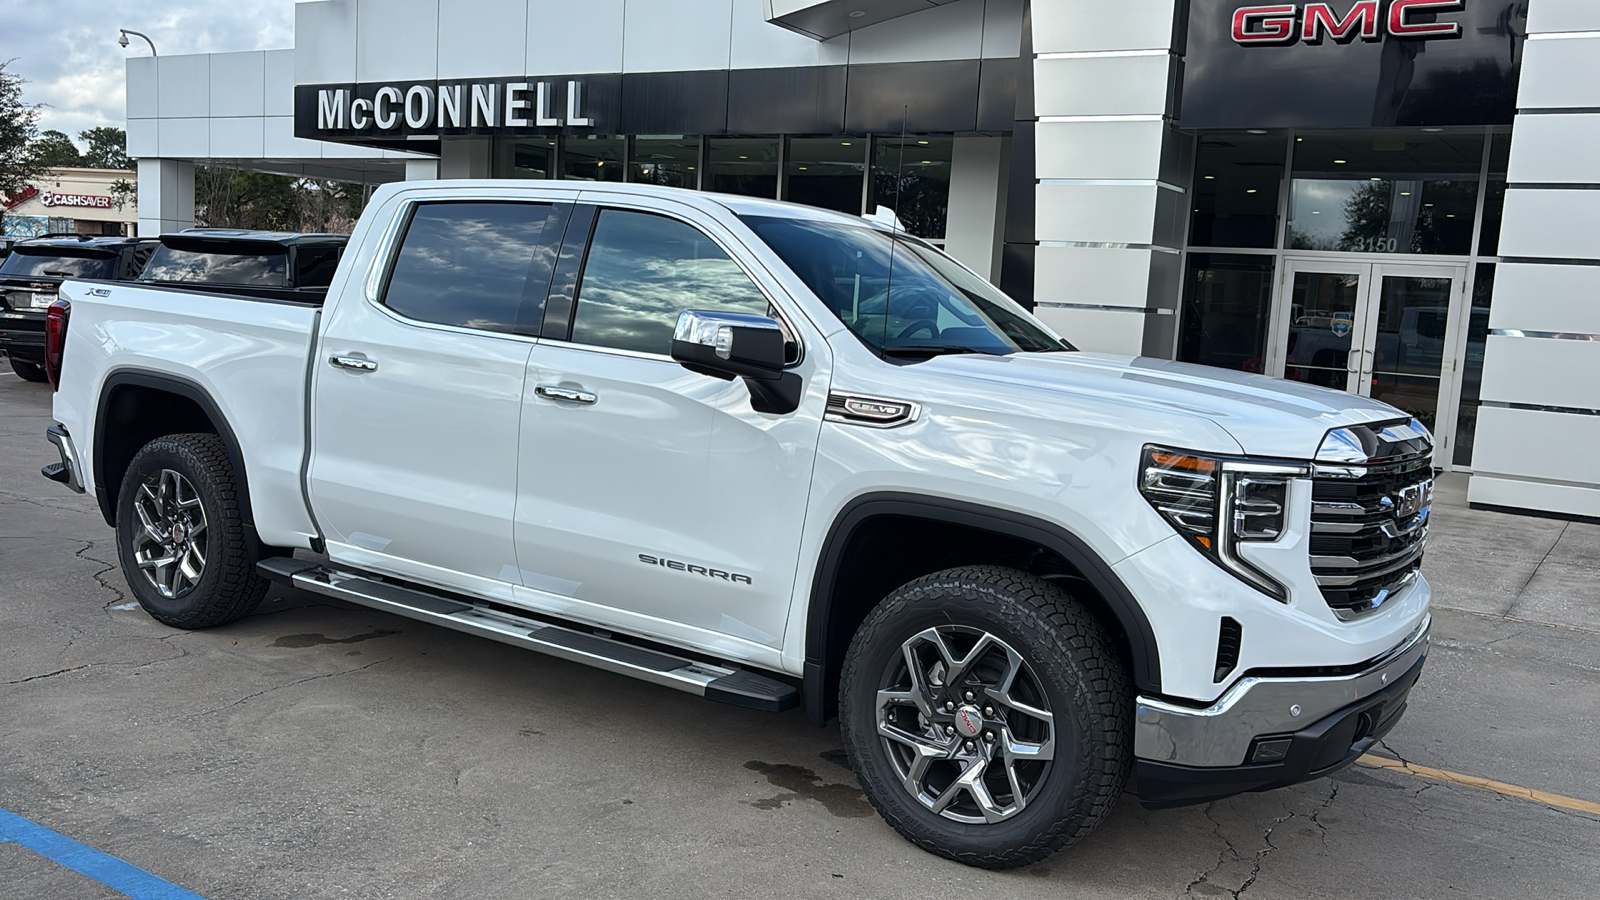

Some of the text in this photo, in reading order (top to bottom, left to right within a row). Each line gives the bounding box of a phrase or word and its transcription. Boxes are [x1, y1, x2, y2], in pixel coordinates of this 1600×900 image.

[1231, 0, 1465, 43] GMC
[317, 81, 594, 130] McCONNELL
[1356, 237, 1397, 252] 3150
[638, 553, 752, 585] SIERRA
